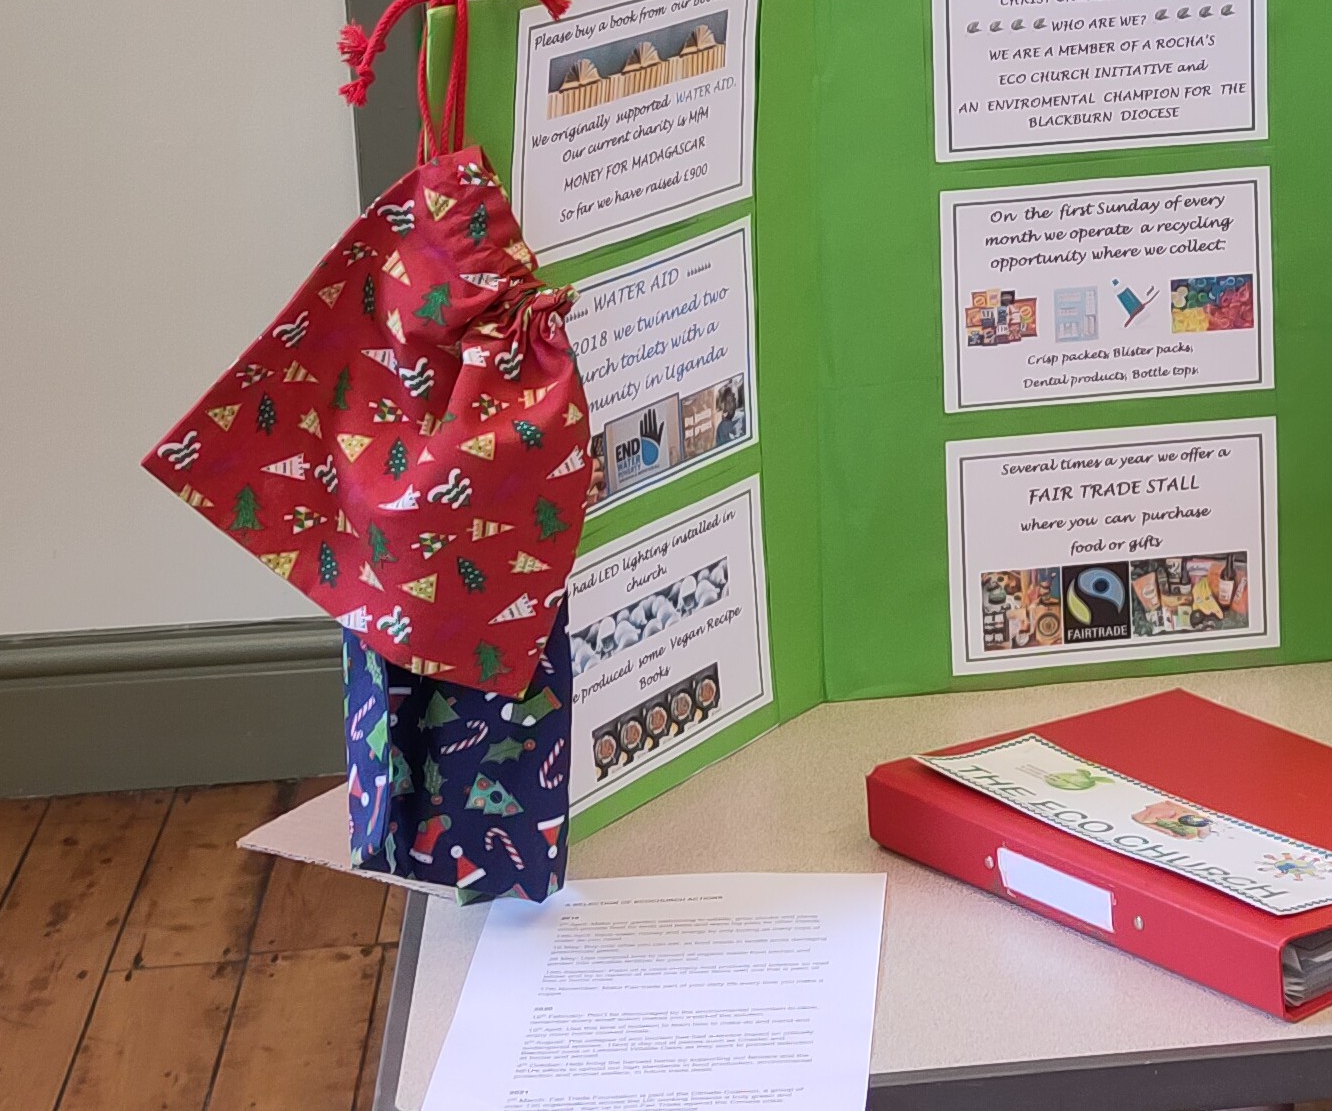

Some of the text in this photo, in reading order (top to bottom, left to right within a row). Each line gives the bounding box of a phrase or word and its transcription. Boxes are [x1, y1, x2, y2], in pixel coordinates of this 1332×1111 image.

[534, 28, 574, 51] Please
[574, 16, 596, 40] buy
[598, 21, 608, 32] a
[609, 10, 639, 30] book
[639, 6, 667, 24] from
[1052, 15, 1146, 31] WHO ARE WE?
[989, 34, 1215, 61] WE ARE A MEMBER OF A ROCHA'S
[999, 59, 1208, 85] ECO CHURCH INITIATIVE and
[959, 83, 1246, 113] AN ENVIROMENTAL CHAMPION FOR THE
[531, 134, 551, 149] We
[551, 114, 611, 144] originally
[616, 94, 671, 124] supported
[676, 83, 711, 104] WATER
[1028, 107, 1180, 128] BLACKBURN DIOCESE
[562, 147, 586, 162] Our
[588, 130, 631, 154] current
[633, 119, 674, 140] charity
[677, 115, 687, 126] is
[564, 136, 705, 191] MONEY FOR MADAGASCAR
[560, 163, 708, 223] So far we have raised £900
[990, 195, 1225, 223] On the first Sunday of every
[985, 216, 1234, 246] month we operate a recycling
[594, 268, 679, 313] WATER AID
[613, 325, 635, 341] we
[637, 294, 701, 332] twinned
[703, 288, 729, 306] two
[645, 346, 728, 390] in Uganda
[1028, 355, 1058, 366] Crisp
[1113, 346, 1154, 358] Blister
[1023, 374, 1070, 389] Dental
[1132, 366, 1171, 379] Bottle
[615, 438, 640, 464] END
[1001, 447, 1231, 475] Several times a year we offer a
[1029, 475, 1199, 505] FAIR TRADE STALL
[1021, 506, 1211, 531] where you can purchase
[572, 511, 735, 597] had LED lighting installed in
[1071, 535, 1163, 556] food or gifts
[1067, 625, 1128, 640] FAIRTRADE
[581, 660, 634, 700] produced
[639, 647, 666, 669] some
[670, 626, 706, 650] Vegan
[706, 607, 742, 630] Recipe
[639, 666, 670, 690] Books
[958, 764, 1291, 900] THE ECO CHURCH
